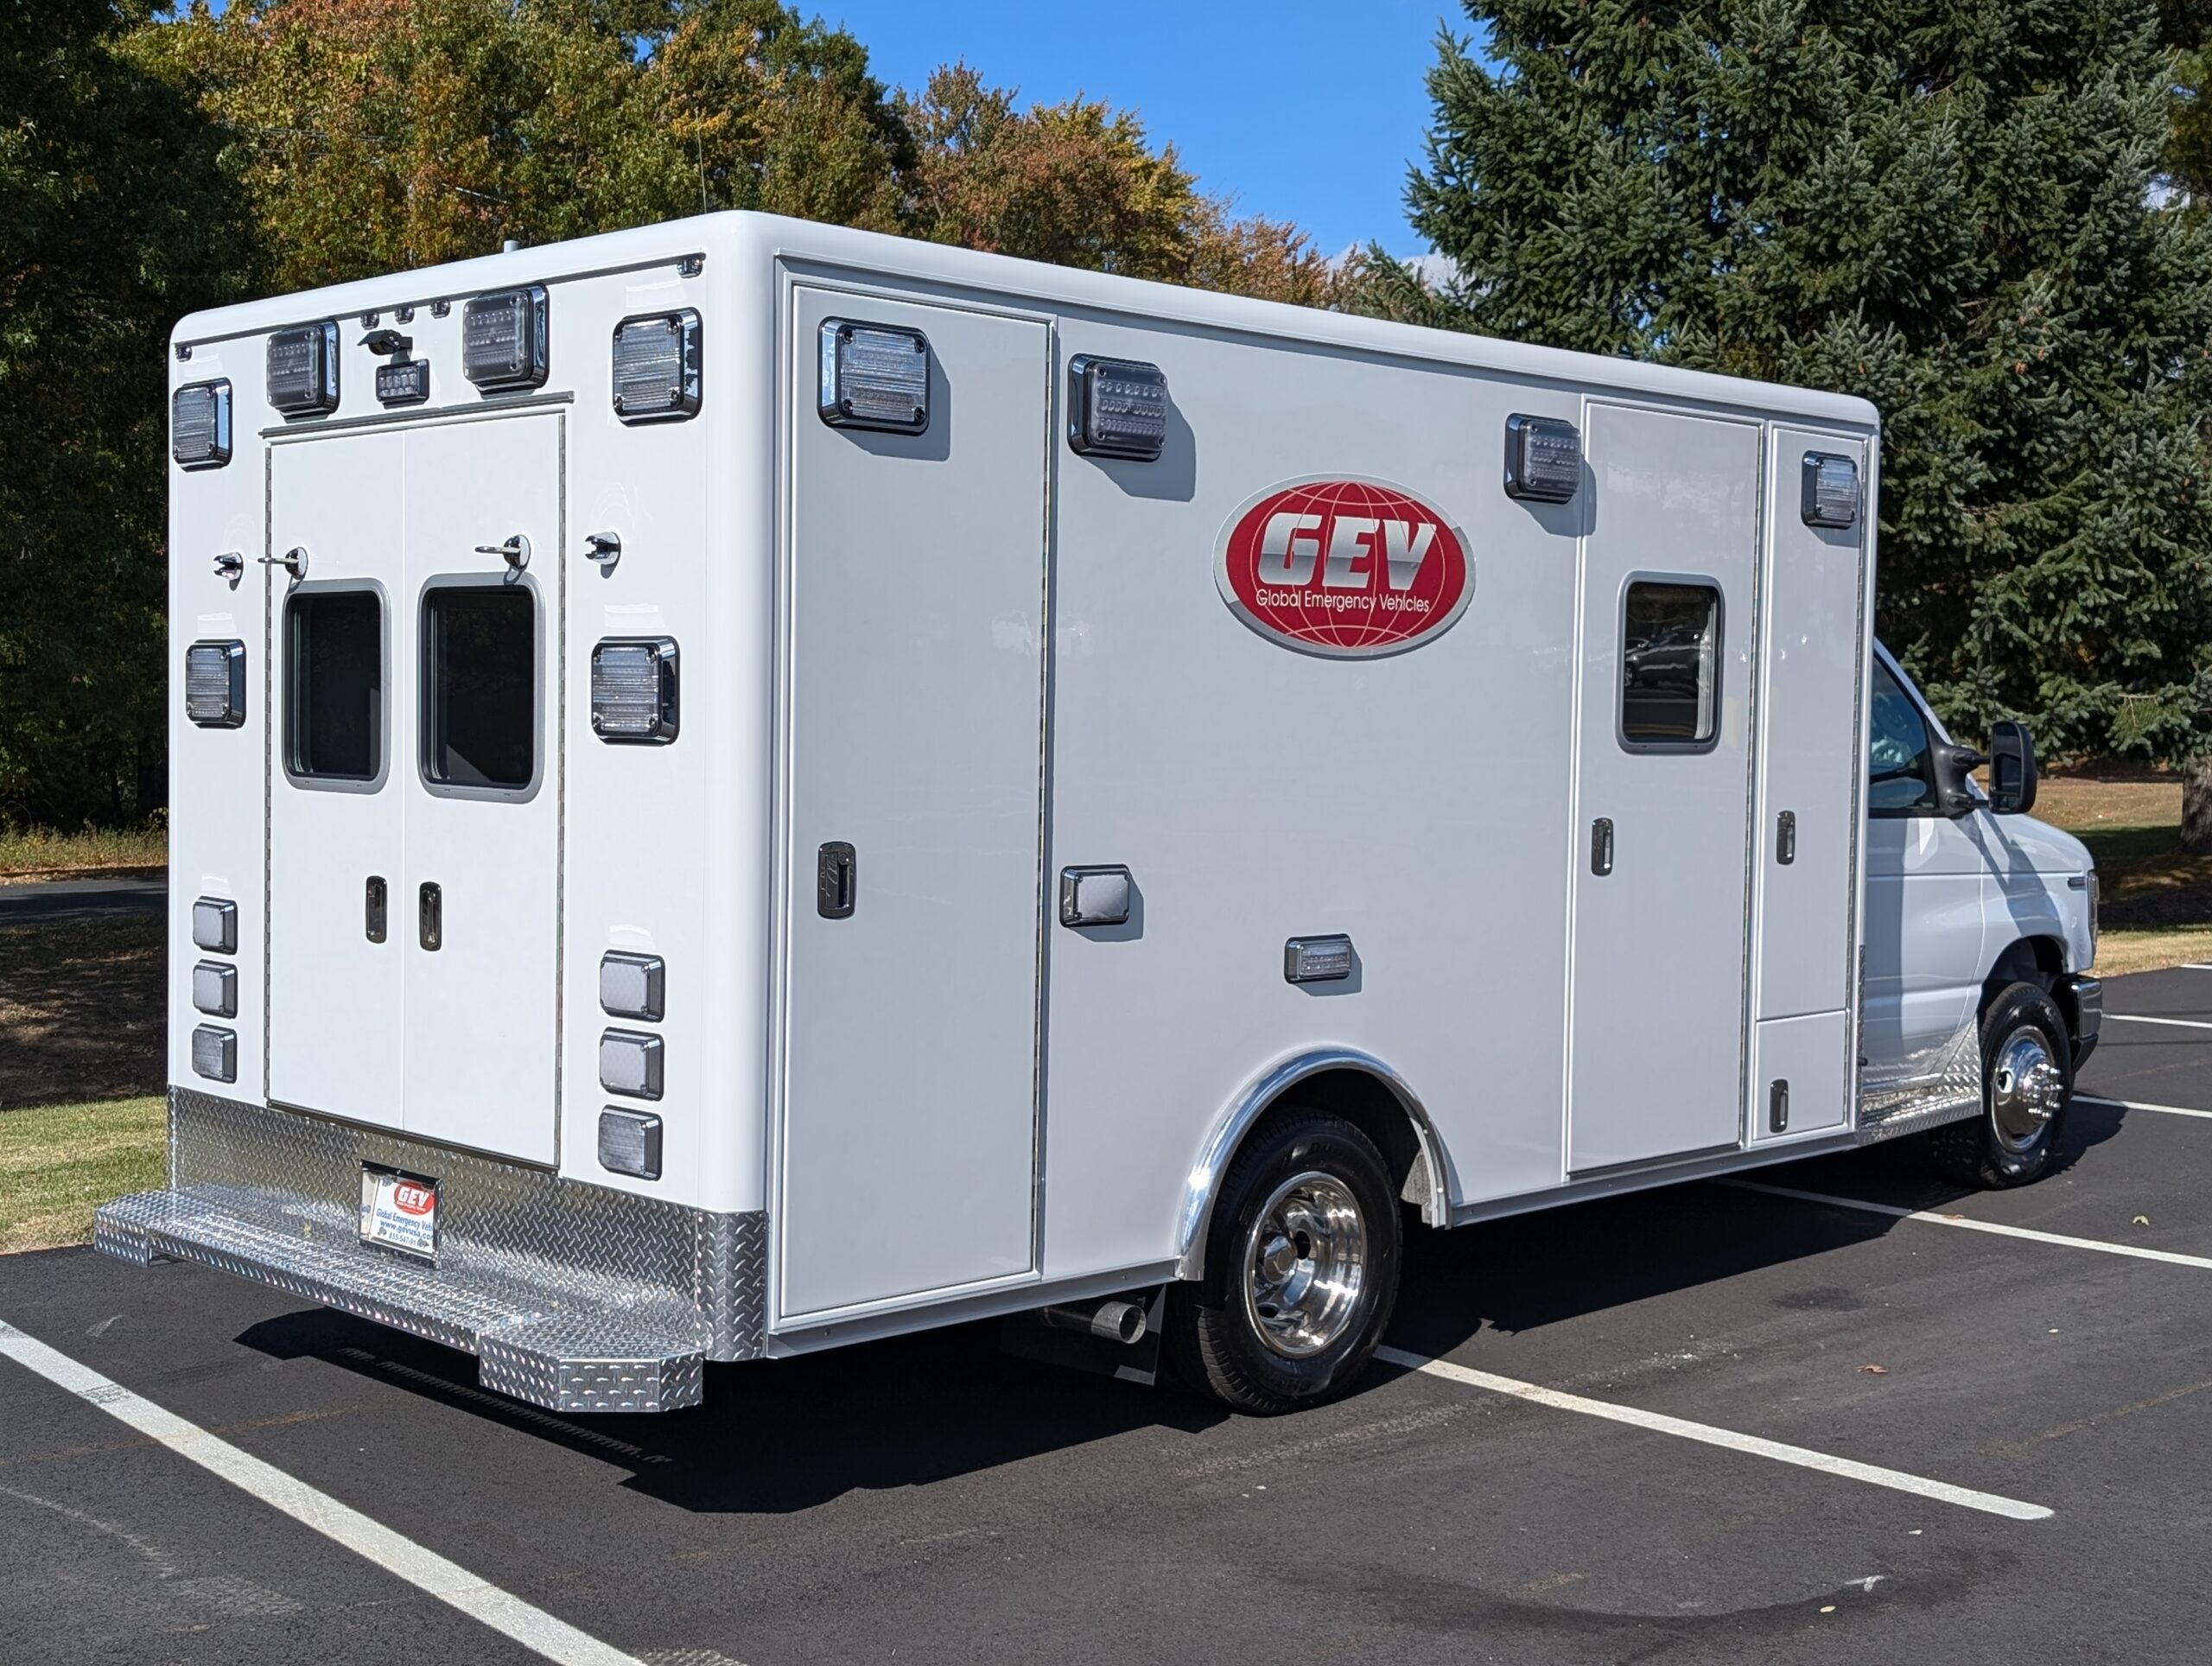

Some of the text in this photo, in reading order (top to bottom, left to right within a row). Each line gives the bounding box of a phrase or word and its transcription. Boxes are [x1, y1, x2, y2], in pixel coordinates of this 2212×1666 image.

[1257, 512, 1437, 591] GEV
[1255, 588, 1430, 613] Global Emergency Vehicles
[397, 1186, 429, 1207] GEV
[376, 1208, 392, 1220] Global
[392, 1212, 421, 1230] Emergency
[380, 1220, 433, 1240] www.gevusa.co
